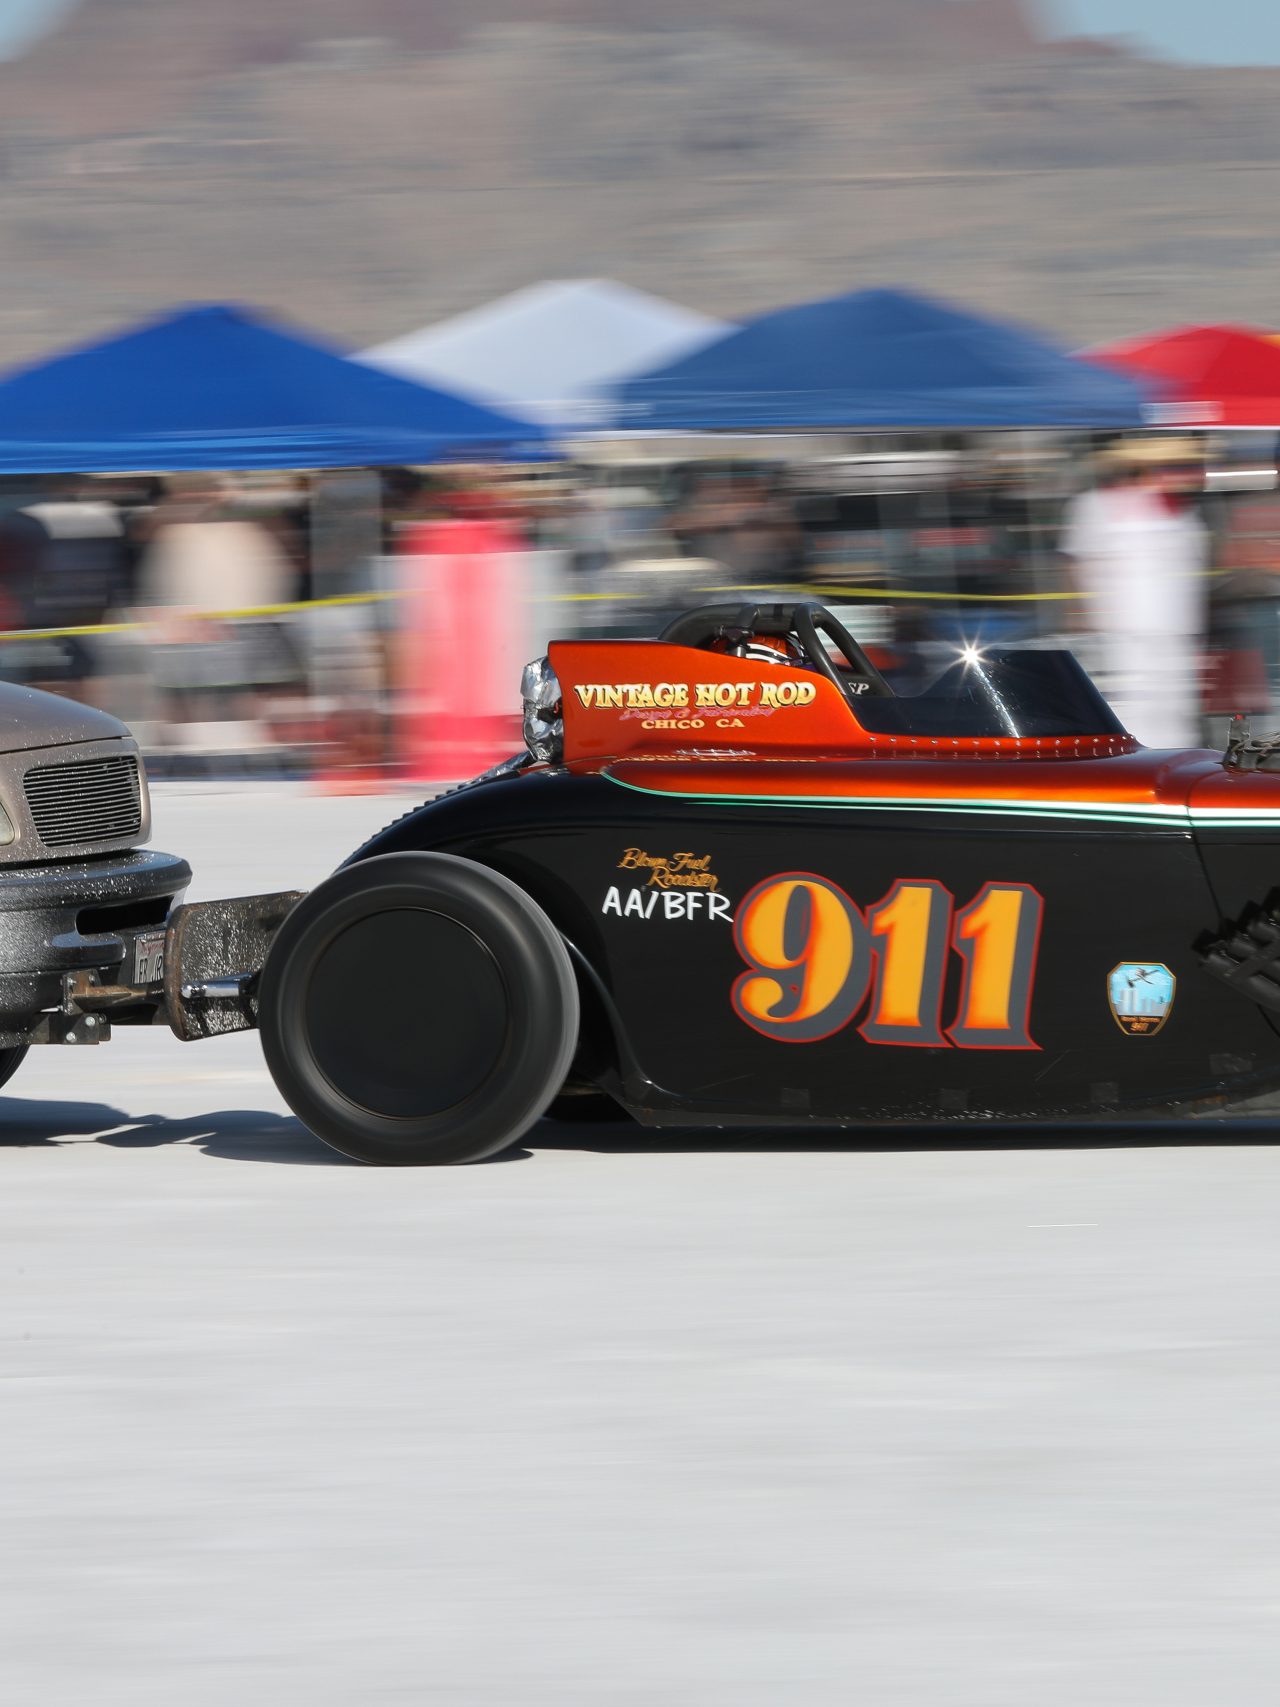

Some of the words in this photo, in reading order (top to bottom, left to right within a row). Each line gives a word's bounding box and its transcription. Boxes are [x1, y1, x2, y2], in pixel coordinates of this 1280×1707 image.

[574, 682, 690, 709] VINTAGE
[695, 683, 753, 707] HOT
[760, 681, 817, 709] ROD
[641, 719, 705, 729] CHICO
[716, 718, 745, 728] CA
[616, 847, 668, 869] Blown
[668, 852, 712, 872] Fuel
[645, 865, 722, 893] Roadster
[601, 885, 735, 923] AA/BFR
[731, 871, 1044, 1050] 911
